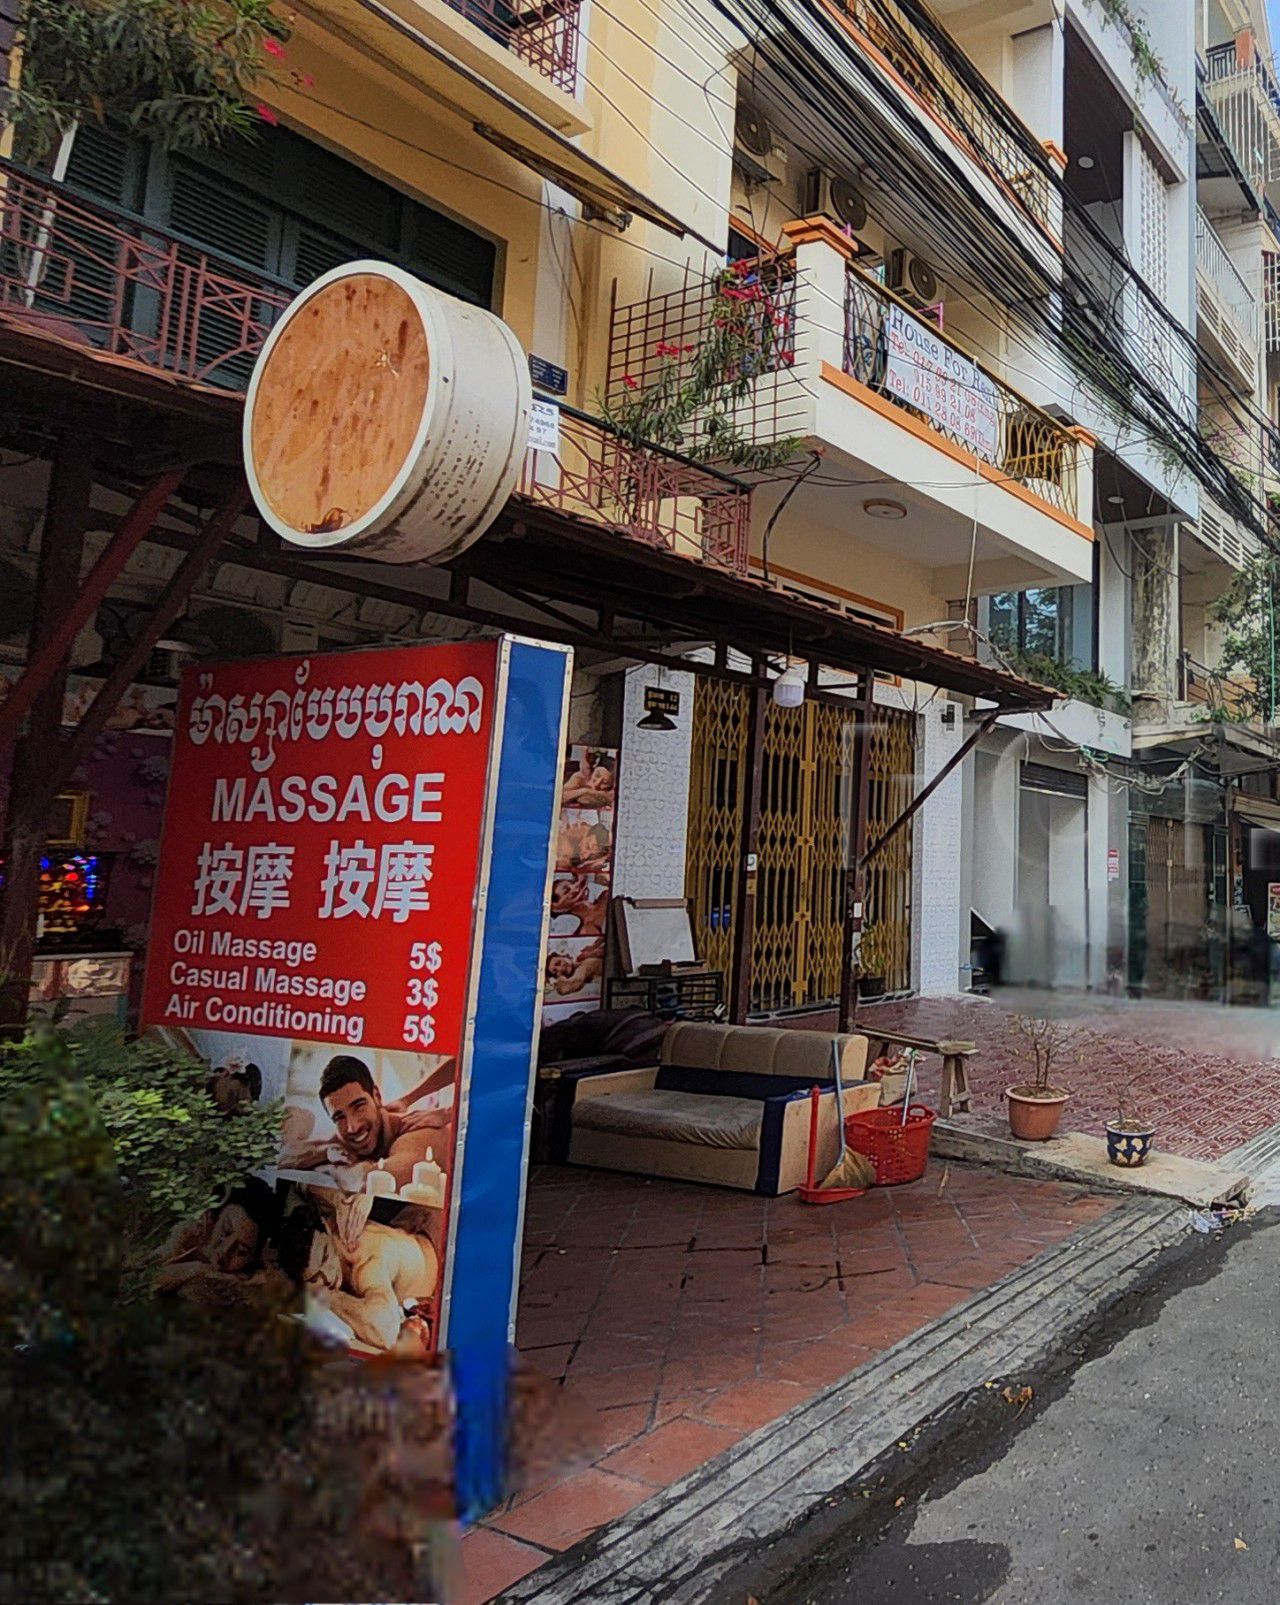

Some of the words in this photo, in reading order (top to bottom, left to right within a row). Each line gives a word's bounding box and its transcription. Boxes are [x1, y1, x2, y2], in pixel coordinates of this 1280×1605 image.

[891, 305, 939, 360] House
[943, 345, 968, 381] For
[889, 369, 909, 396] Tel:
[212, 773, 446, 823] MASSAGE
[191, 841, 296, 920] 按摩
[318, 839, 436, 923] 按摩
[173, 930, 206, 954] Oil
[211, 932, 317, 967] Massage
[409, 941, 443, 973] 5$
[170, 961, 248, 992] Casual
[254, 969, 366, 1006] Massage
[406, 979, 439, 1010] 3$
[165, 993, 198, 1019] Air
[205, 999, 365, 1042] Conditioning
[402, 1014, 436, 1047] 5$
